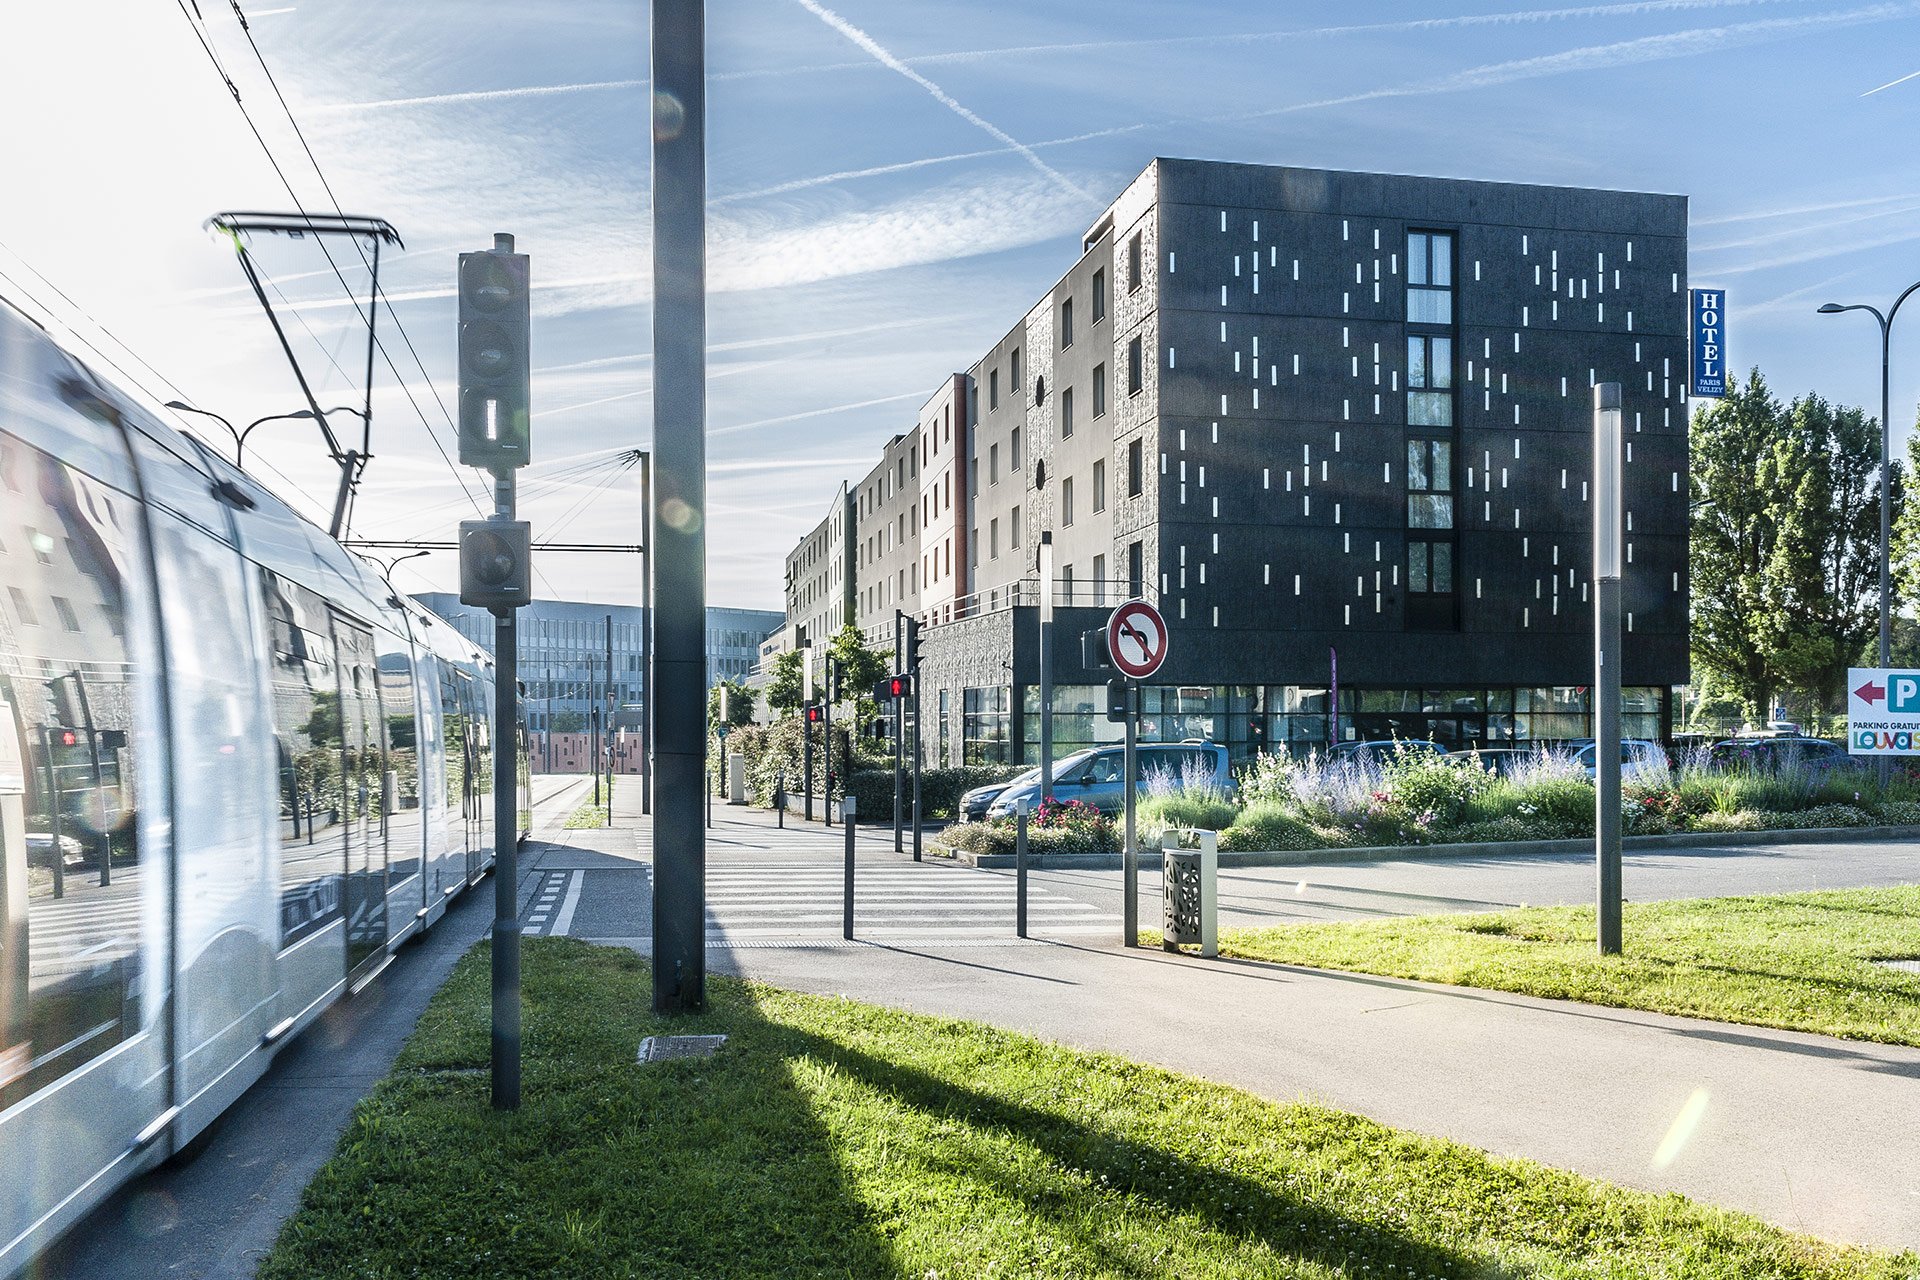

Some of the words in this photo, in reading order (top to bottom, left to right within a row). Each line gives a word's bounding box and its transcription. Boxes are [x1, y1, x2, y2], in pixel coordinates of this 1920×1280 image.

[1701, 293, 1718, 377] HOTEL
[1896, 679, 1917, 707] P
[1890, 722, 1920, 730] GRATUI
